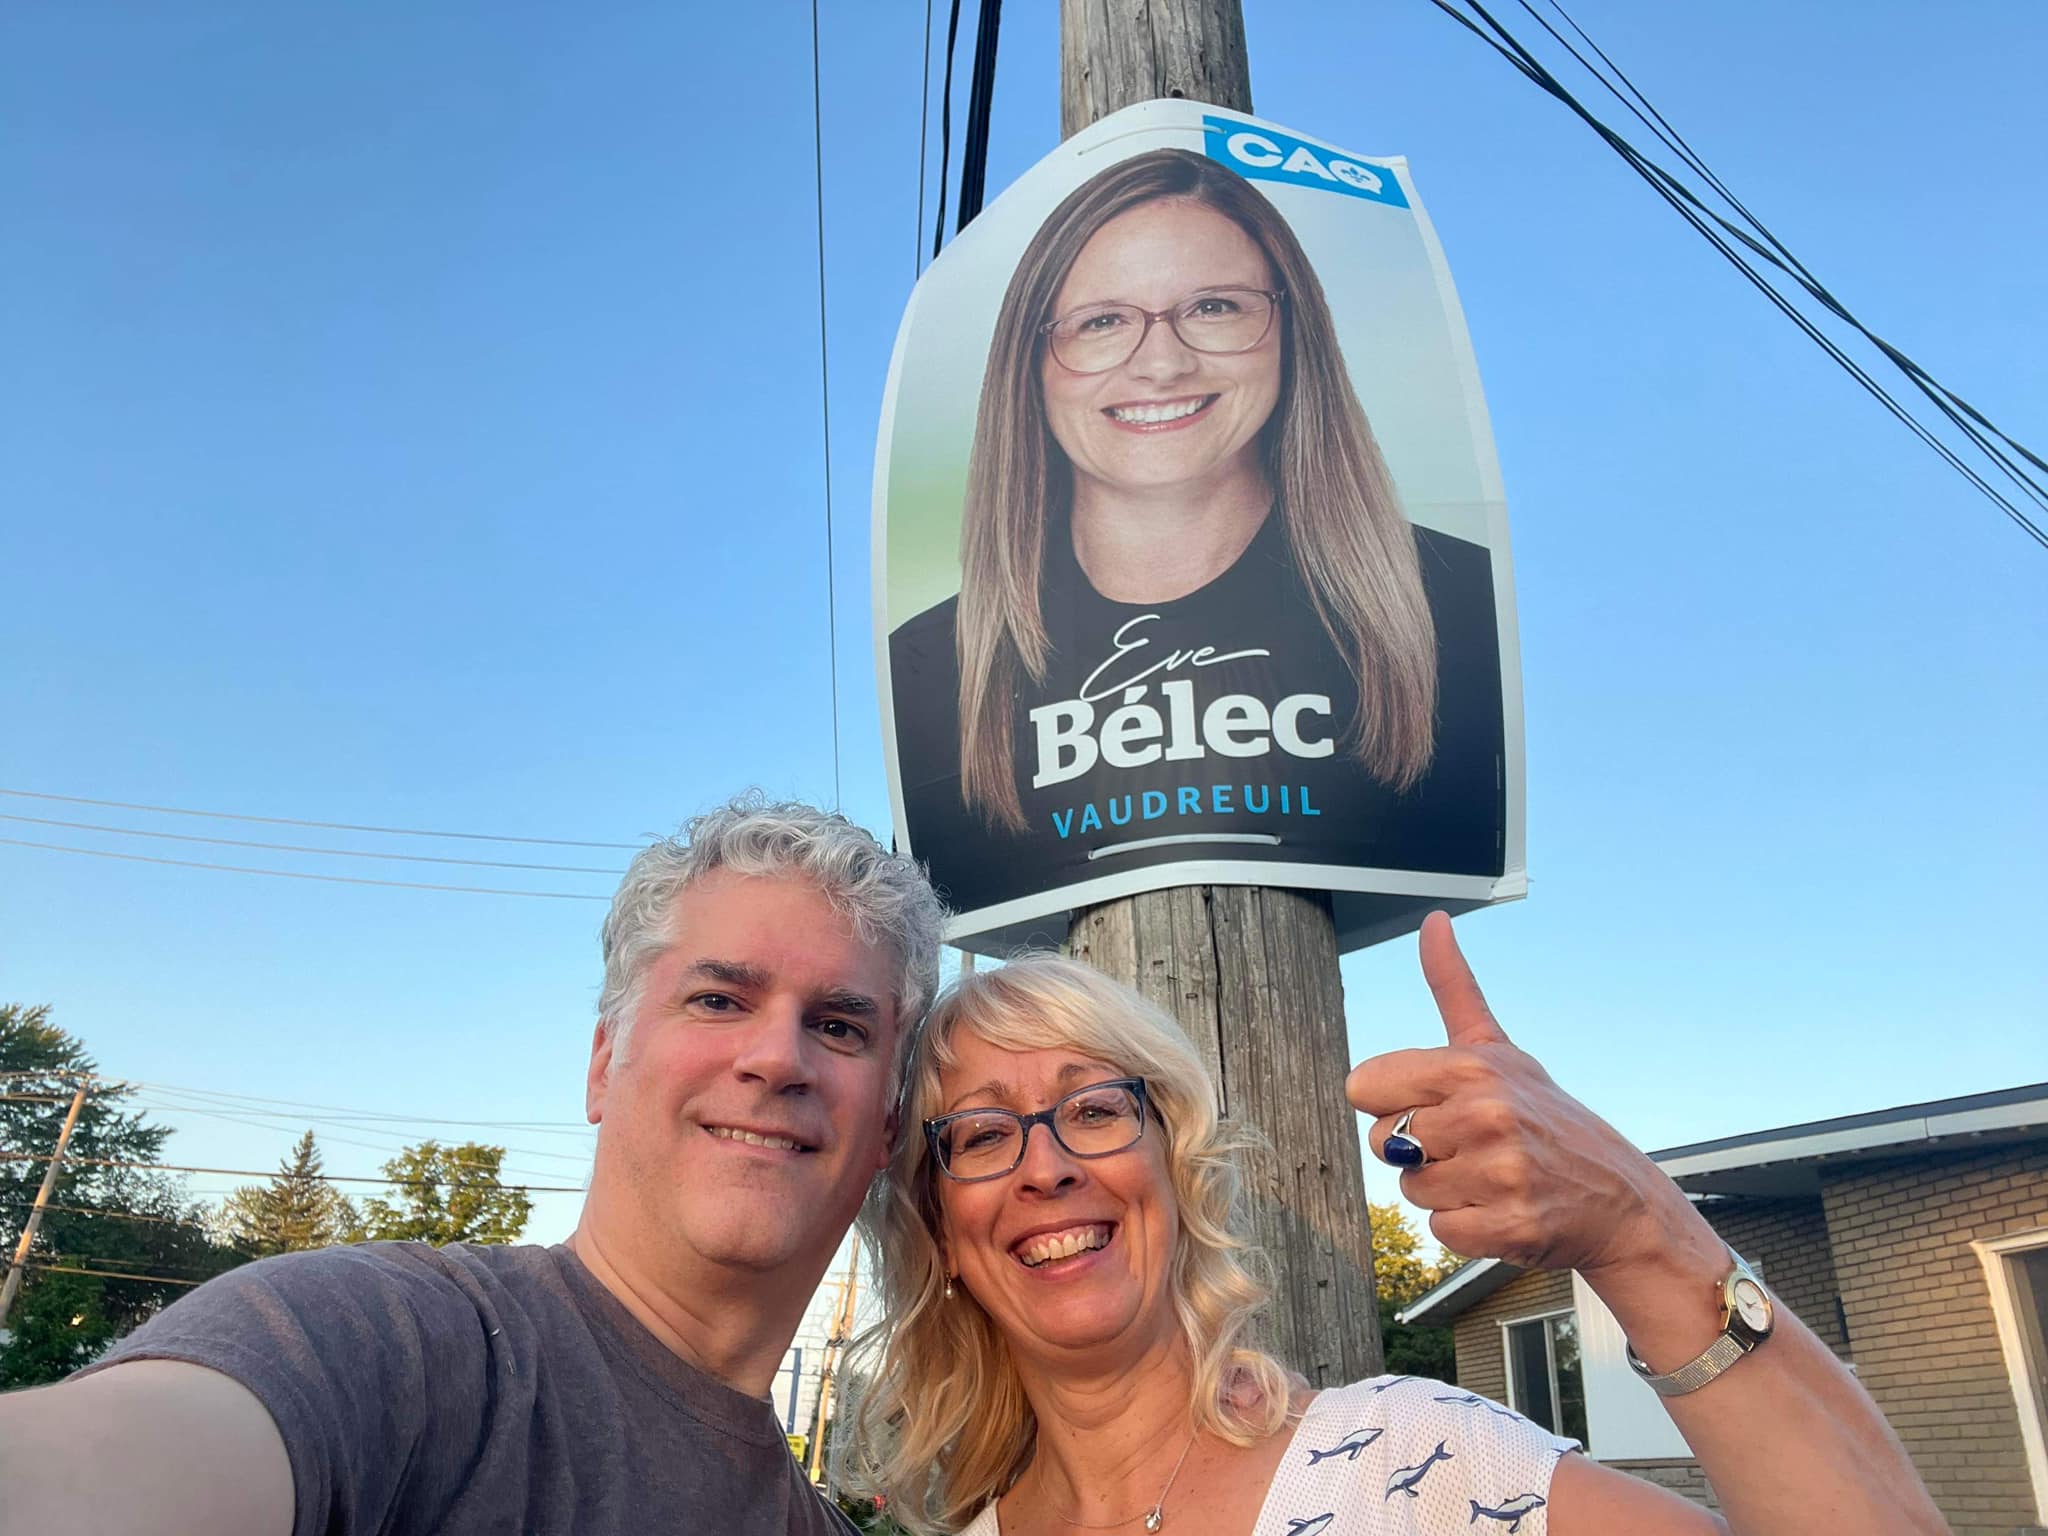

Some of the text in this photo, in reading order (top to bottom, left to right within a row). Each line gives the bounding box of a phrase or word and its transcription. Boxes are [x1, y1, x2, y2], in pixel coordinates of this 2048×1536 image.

[1227, 132, 1383, 195] CAQ
[1079, 613, 1270, 702] Eve
[1029, 679, 1335, 790] Bélec
[1052, 784, 1321, 839] VAUDREUIL
